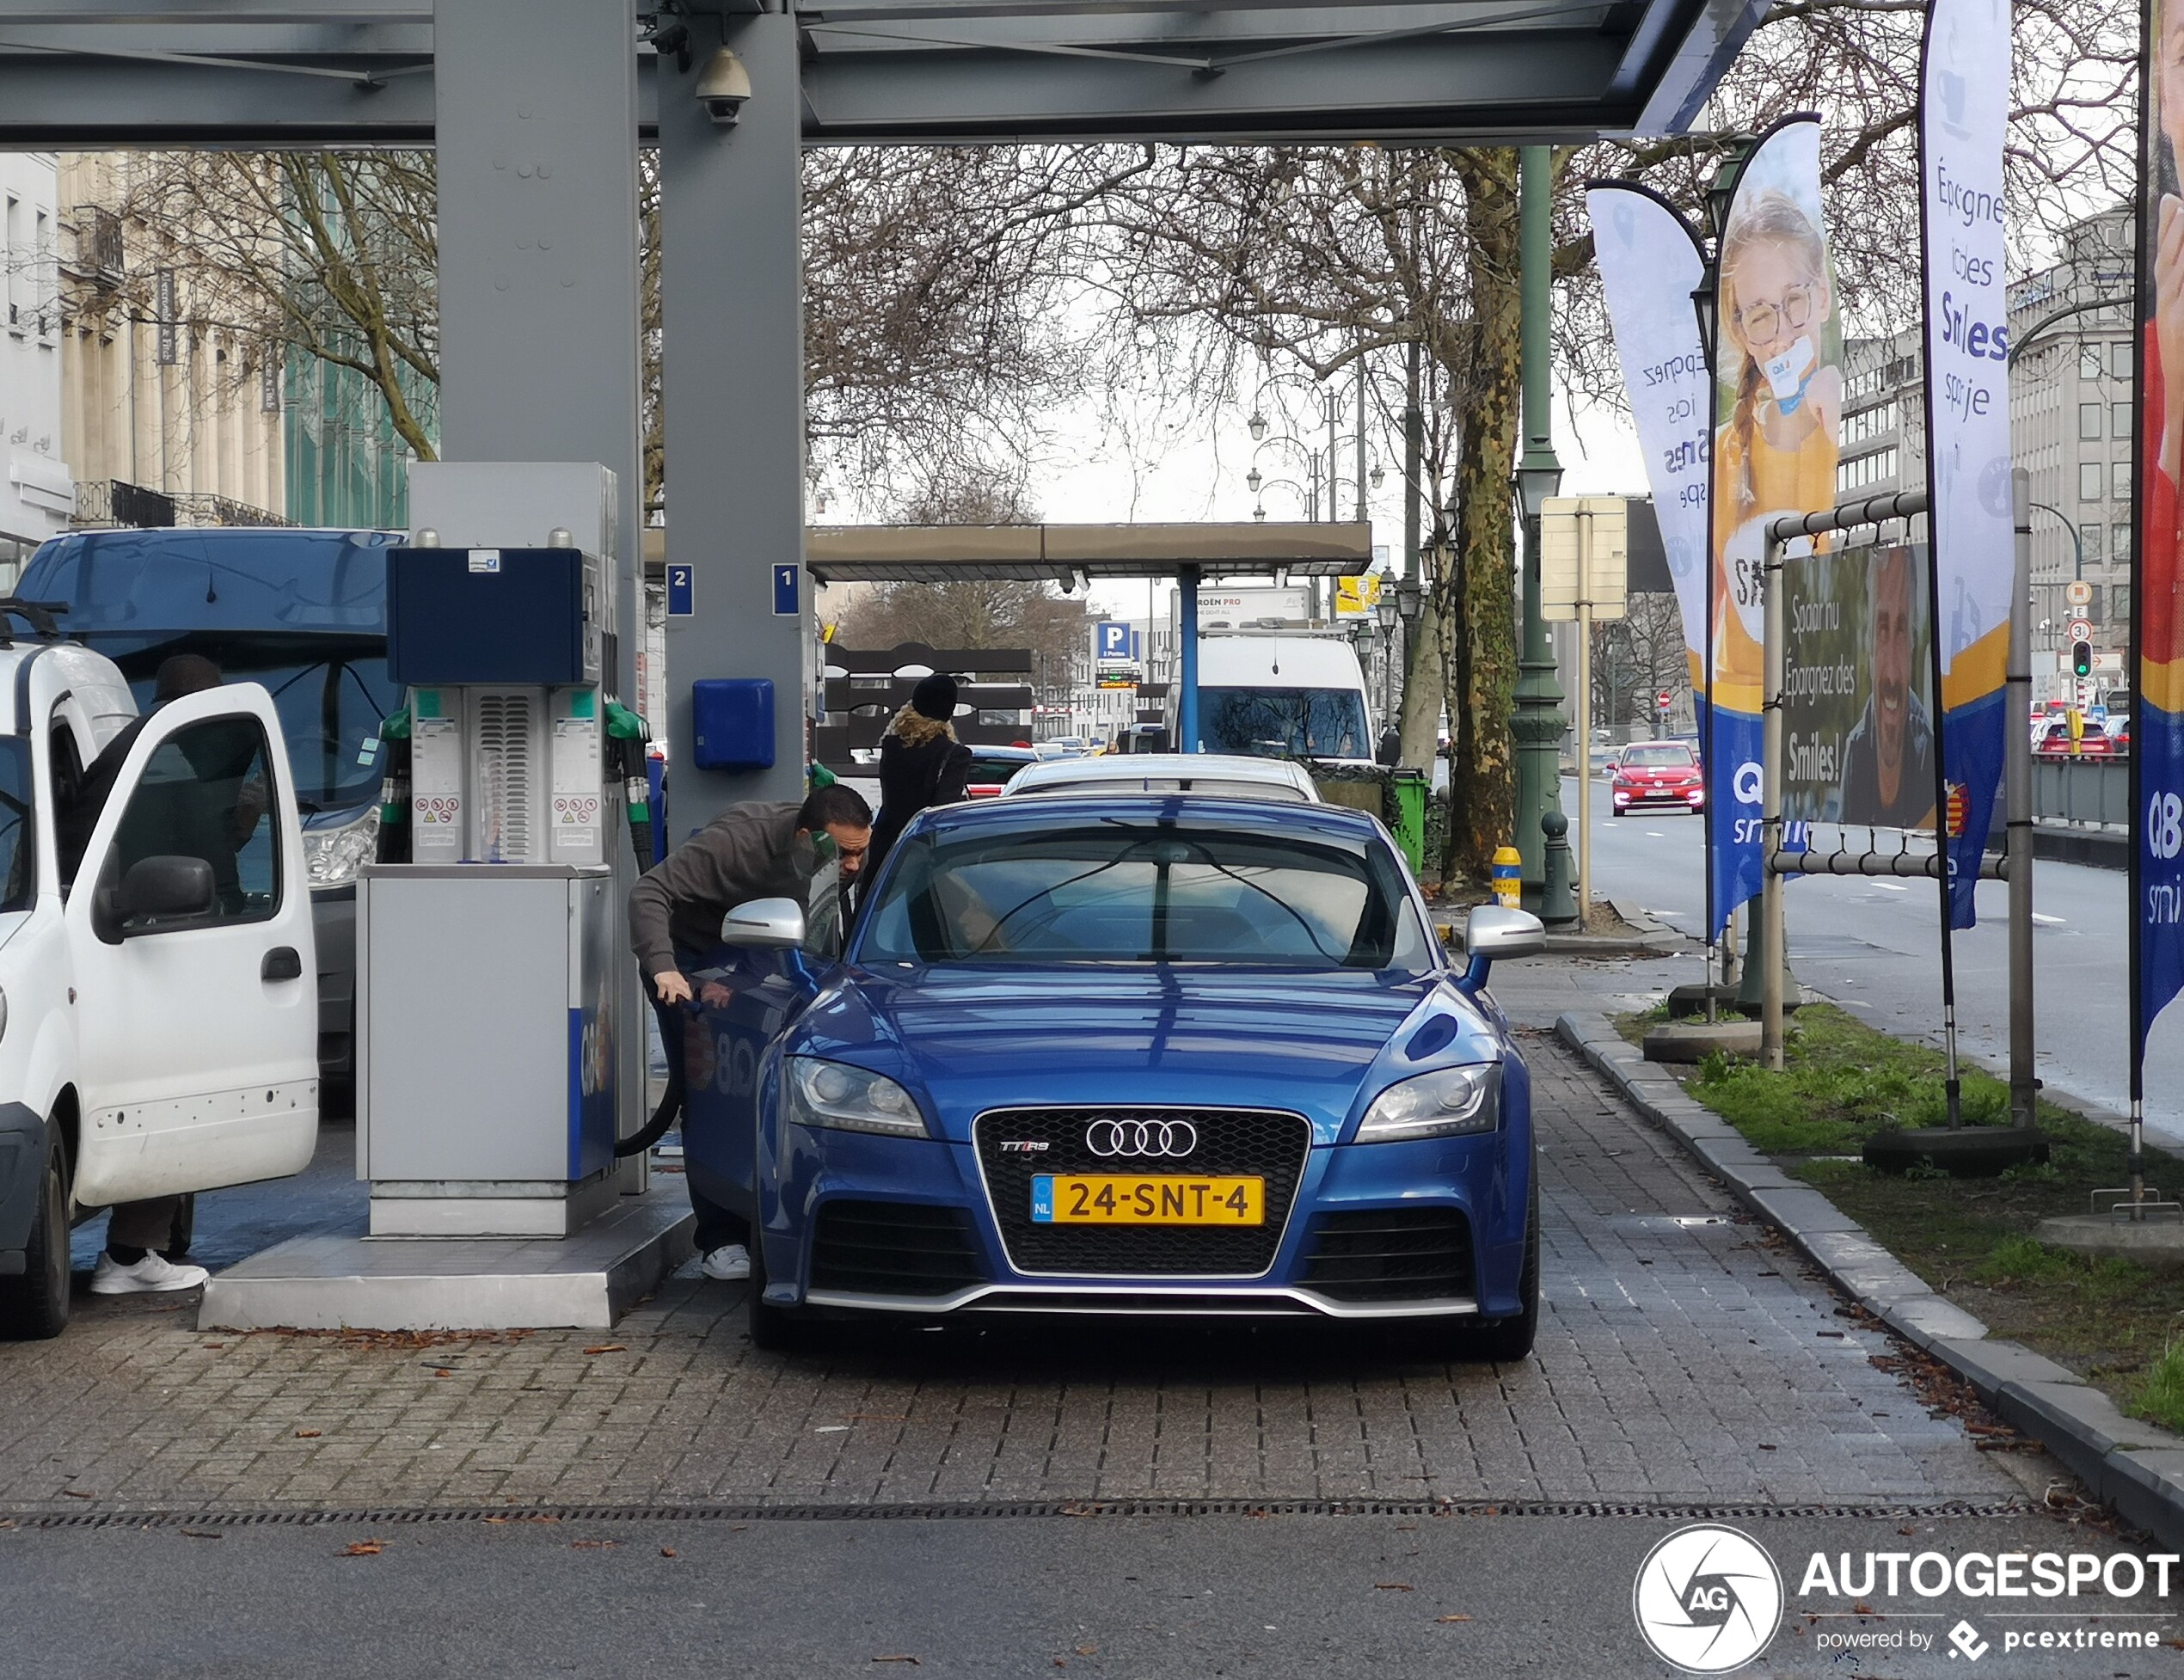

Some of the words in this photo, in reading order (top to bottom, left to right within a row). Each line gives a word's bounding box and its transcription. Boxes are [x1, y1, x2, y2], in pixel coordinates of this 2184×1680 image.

[674, 571, 685, 586] 2
[782, 570, 791, 586] 1
[1792, 594, 1824, 644] Spaar
[1825, 601, 1839, 630] nu
[1107, 627, 1123, 649] P
[1785, 647, 1834, 707] Épargnez
[1836, 653, 1855, 695] des
[1788, 732, 1839, 782] Smiles!
[1034, 1204, 1051, 1216] NL
[1070, 1183, 1248, 1217] 24-SNT-4
